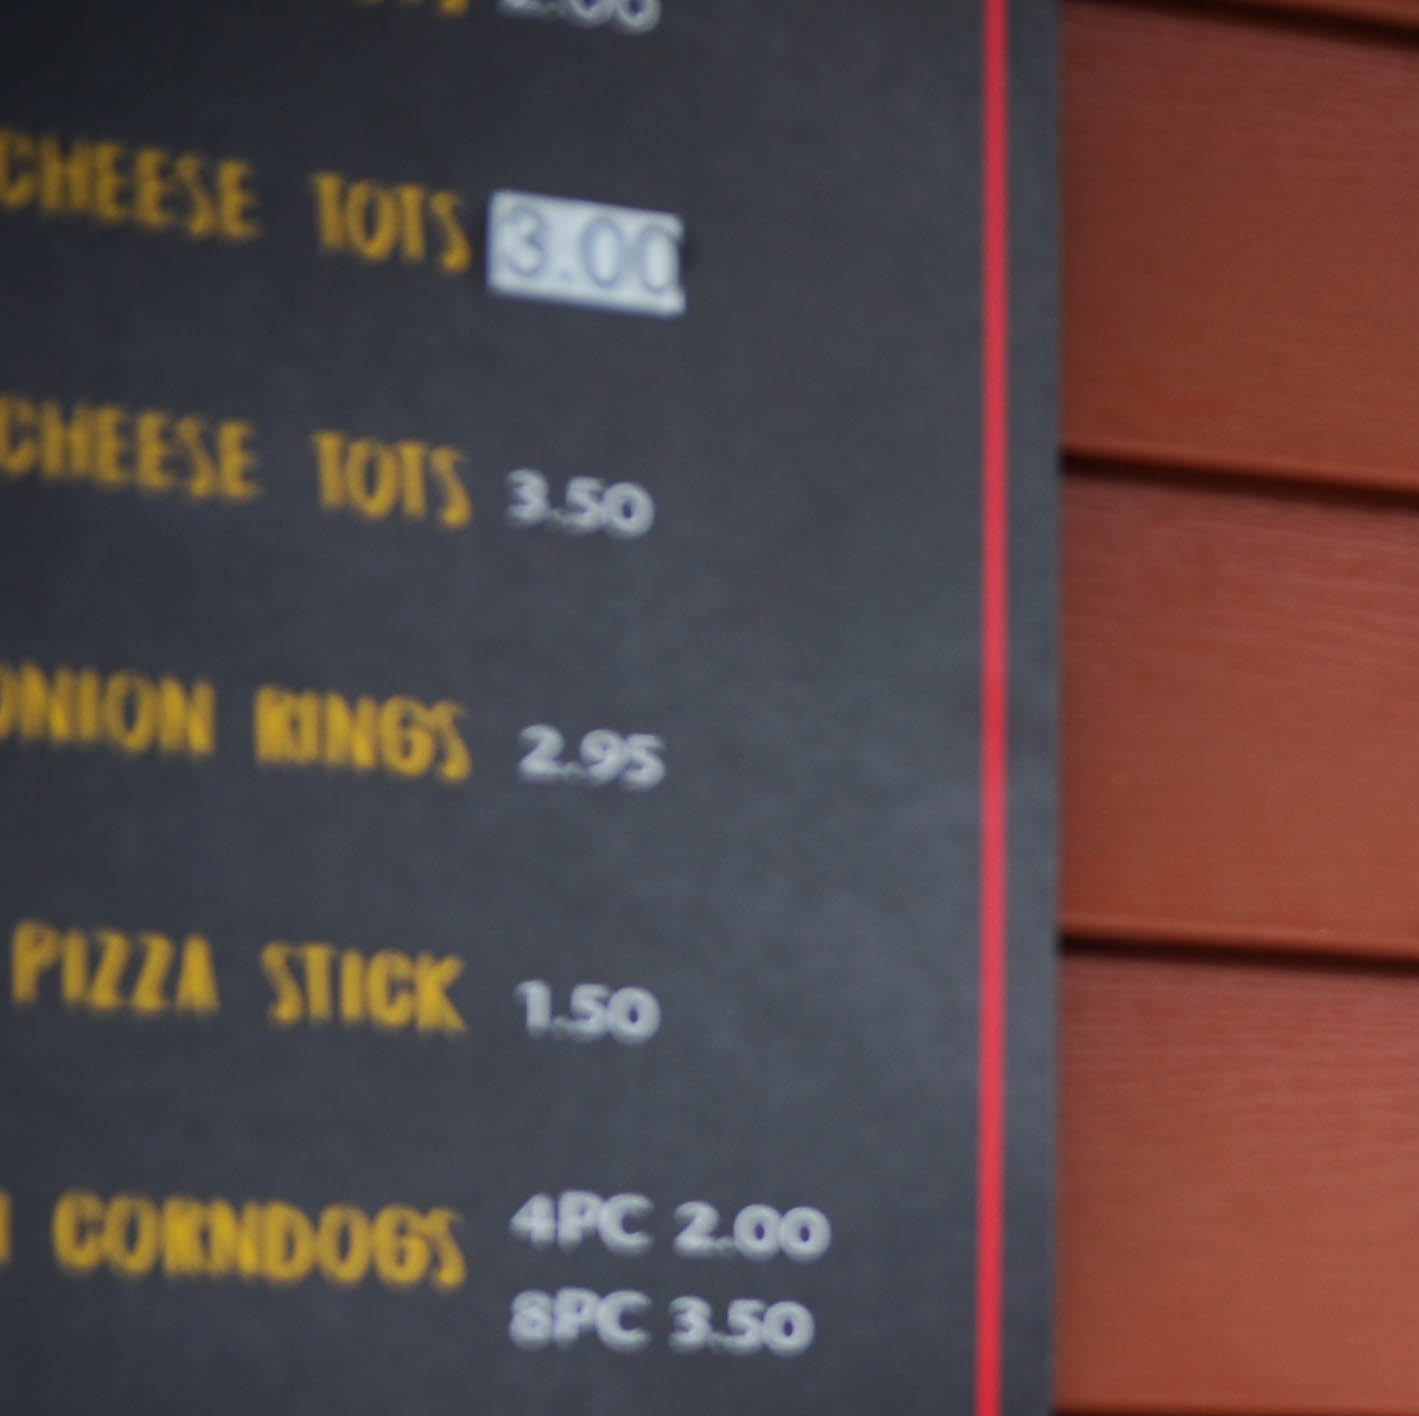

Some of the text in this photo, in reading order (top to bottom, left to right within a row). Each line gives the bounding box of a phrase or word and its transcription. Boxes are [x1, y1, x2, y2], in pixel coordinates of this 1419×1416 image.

[0, 130, 682, 294] CHEESE TOTS 3.00
[0, 398, 655, 538] CHEESE TOTS 3.50
[254, 685, 471, 783] RINGS
[518, 724, 667, 789] 2.95
[12, 921, 662, 1044] PIZZA STICK 1.50
[53, 1193, 466, 1289] CORNDOGS
[509, 1190, 653, 1252] 4PC
[673, 1200, 832, 1262] 2.00
[508, 1288, 816, 1356] 8PC 3.50
